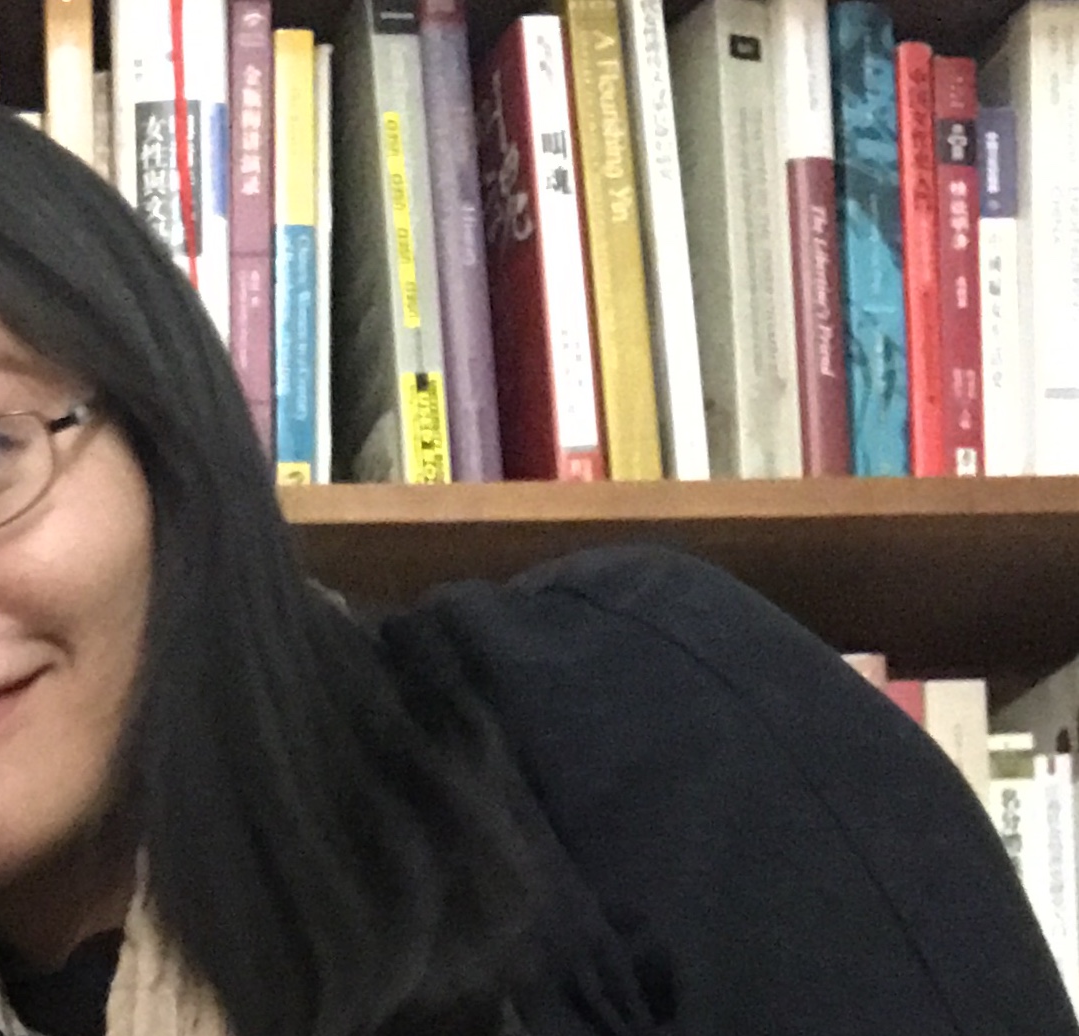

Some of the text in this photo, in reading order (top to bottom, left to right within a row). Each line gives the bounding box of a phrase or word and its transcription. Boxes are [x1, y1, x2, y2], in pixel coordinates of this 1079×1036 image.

[593, 30, 615, 50] A
[608, 185, 632, 222] Yin
[811, 205, 828, 234] The
